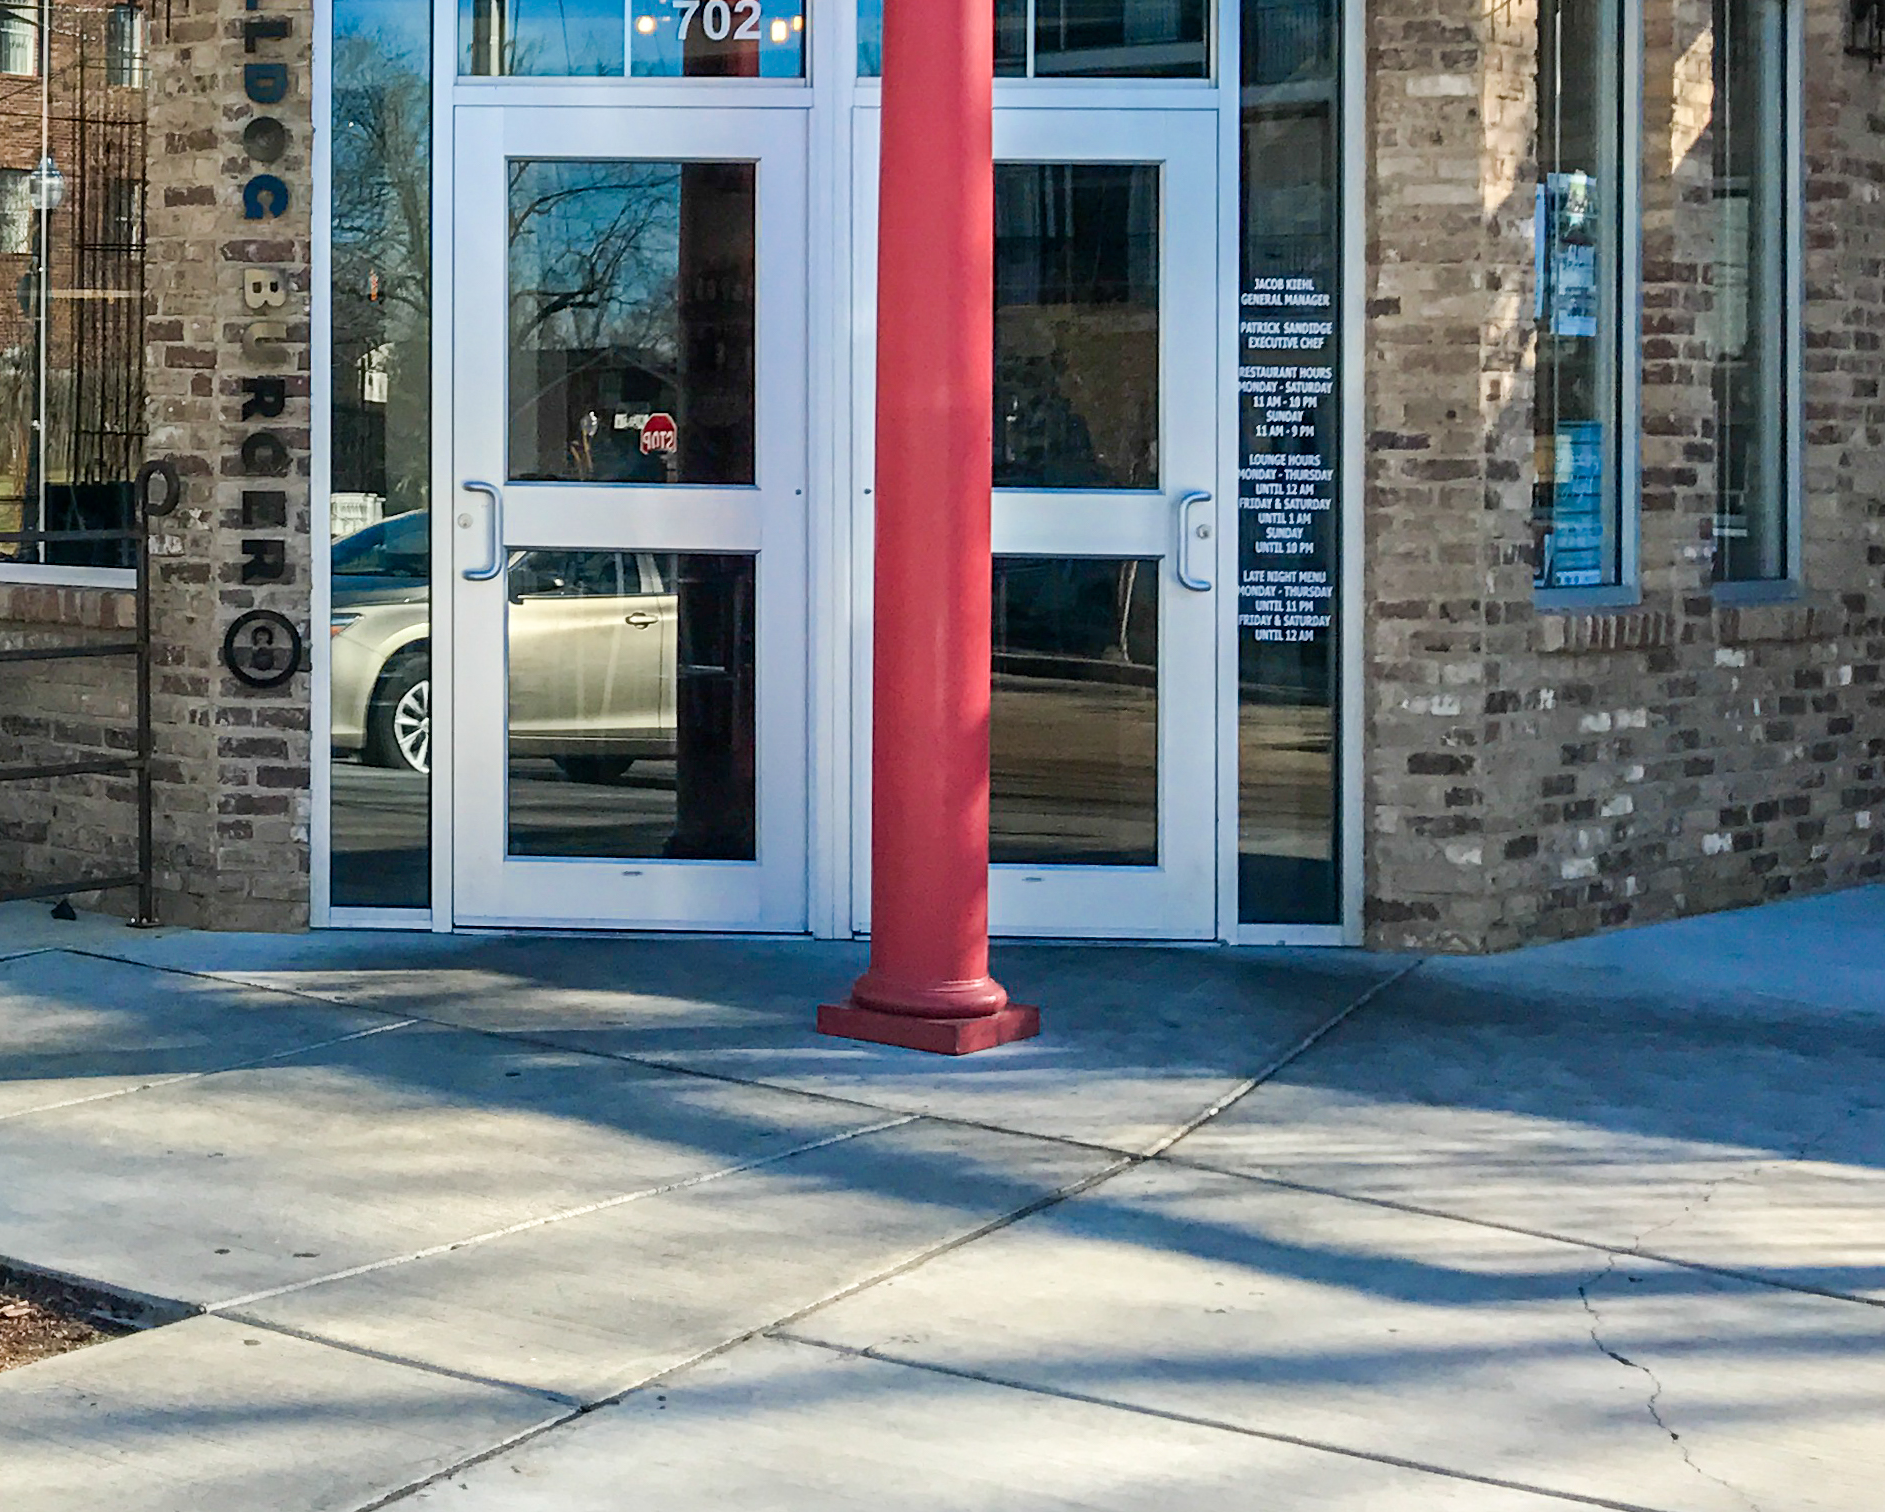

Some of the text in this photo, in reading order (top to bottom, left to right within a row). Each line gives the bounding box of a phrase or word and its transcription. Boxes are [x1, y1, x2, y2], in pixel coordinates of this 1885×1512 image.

[1254, 277, 1285, 290] JACOB
[1240, 292, 1330, 306] GENERAL MANAGER
[1240, 321, 1333, 335] PATRICK SANDIDGE
[1248, 336, 1325, 349] EXECUTIVE CHEF
[1238, 366, 1333, 379] RESTAURANT HOURS
[1285, 381, 1334, 394] SATURDAY
[1253, 395, 1265, 408] 11
[1266, 395, 1282, 408] AM
[1289, 395, 1301, 408] 10
[1302, 395, 1318, 408] PM
[1265, 409, 1304, 422] SUNDAY
[241, 267, 291, 587] BURGER
[1255, 424, 1267, 437] 11
[1268, 424, 1284, 437] AM
[1291, 424, 1298, 437] 9
[1299, 424, 1315, 437] PM
[1248, 453, 1321, 466] LOUNGE HOURS
[1284, 468, 1334, 481] THURSDAY
[1255, 483, 1315, 495] UNTIL 12 AM
[1239, 497, 1332, 510] FRIDAY & SATURDAY
[1257, 512, 1312, 524] UNTIL 1 AM
[1265, 526, 1304, 539] SUNDAY
[1255, 540, 1314, 554] UNTIL 10 PM
[1243, 569, 1327, 583] LATE NIGHT MENU
[1284, 585, 1334, 598] THURSDAY
[1255, 600, 1314, 612] UNTIL 11 PM
[1238, 614, 1332, 627] FRIDAY & SATURDAY
[1255, 629, 1314, 642] UNTIL 12 AM
